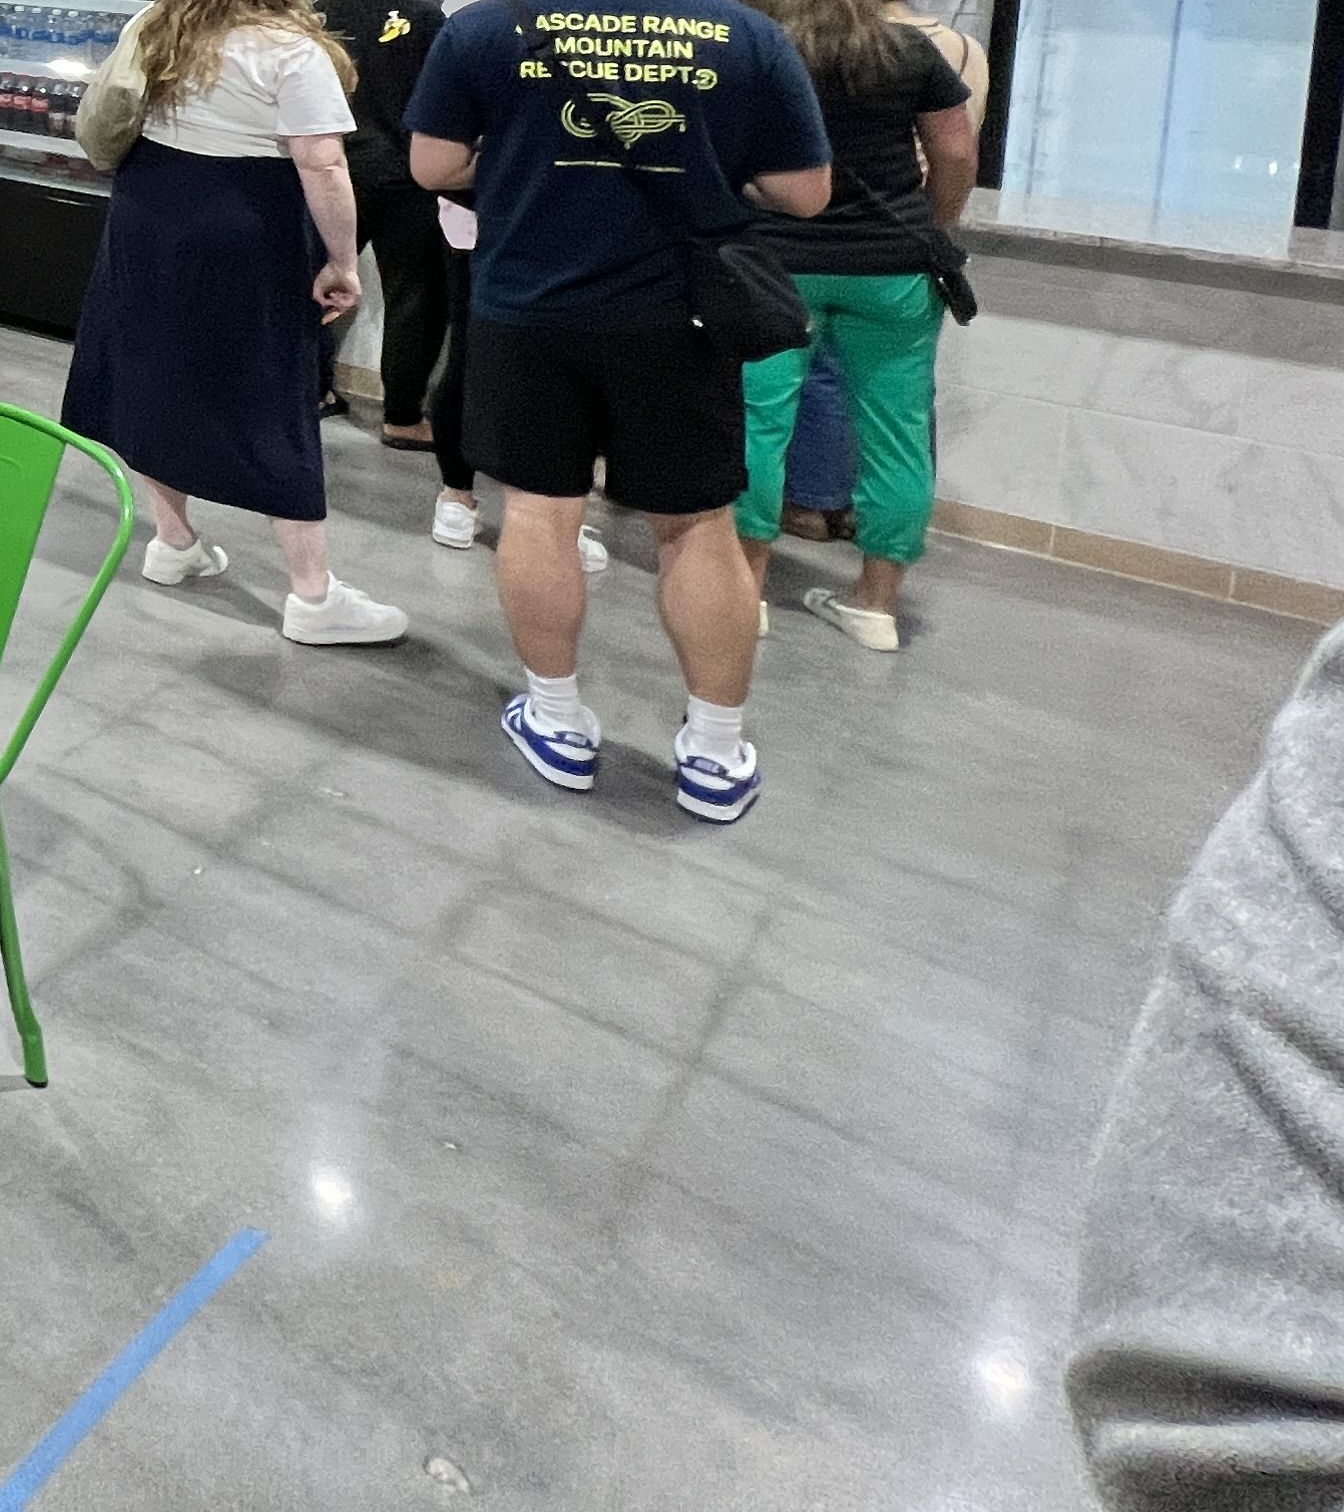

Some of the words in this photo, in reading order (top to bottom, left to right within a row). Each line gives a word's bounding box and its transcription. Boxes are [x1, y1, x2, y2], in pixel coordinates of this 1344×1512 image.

[515, 13, 637, 35] ASCADE
[642, 14, 730, 43] RANGE
[554, 36, 694, 60] MOUNTAIN
[519, 60, 619, 81] RECUE
